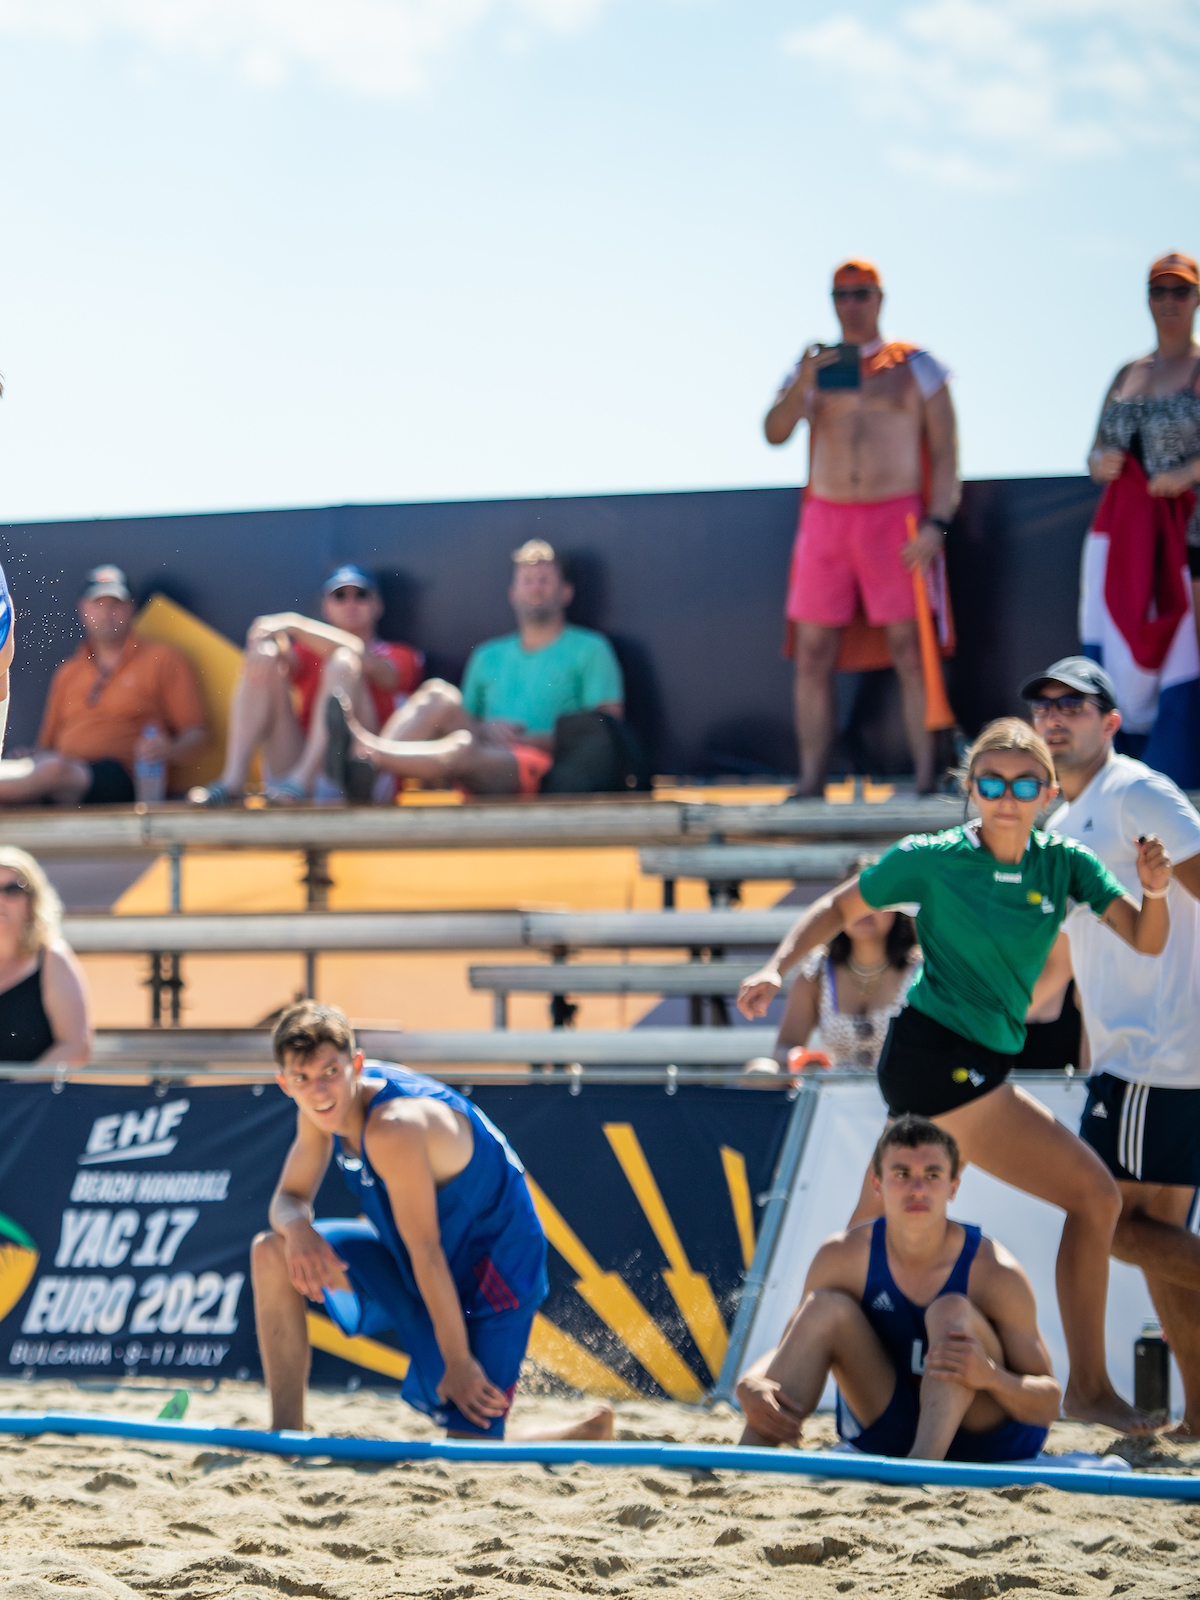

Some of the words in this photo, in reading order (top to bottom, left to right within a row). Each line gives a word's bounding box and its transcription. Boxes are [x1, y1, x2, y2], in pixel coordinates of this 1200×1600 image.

[85, 1098, 191, 1156] EHF
[70, 1170, 140, 1203] BEACH
[134, 1169, 232, 1203] HANDBALL
[54, 1207, 141, 1268] YAC
[130, 1206, 200, 1268] 17
[20, 1273, 137, 1335] EURO
[128, 1270, 246, 1335] 2021
[8, 1338, 113, 1366] BULGARIA
[174, 1339, 231, 1367] JULY
